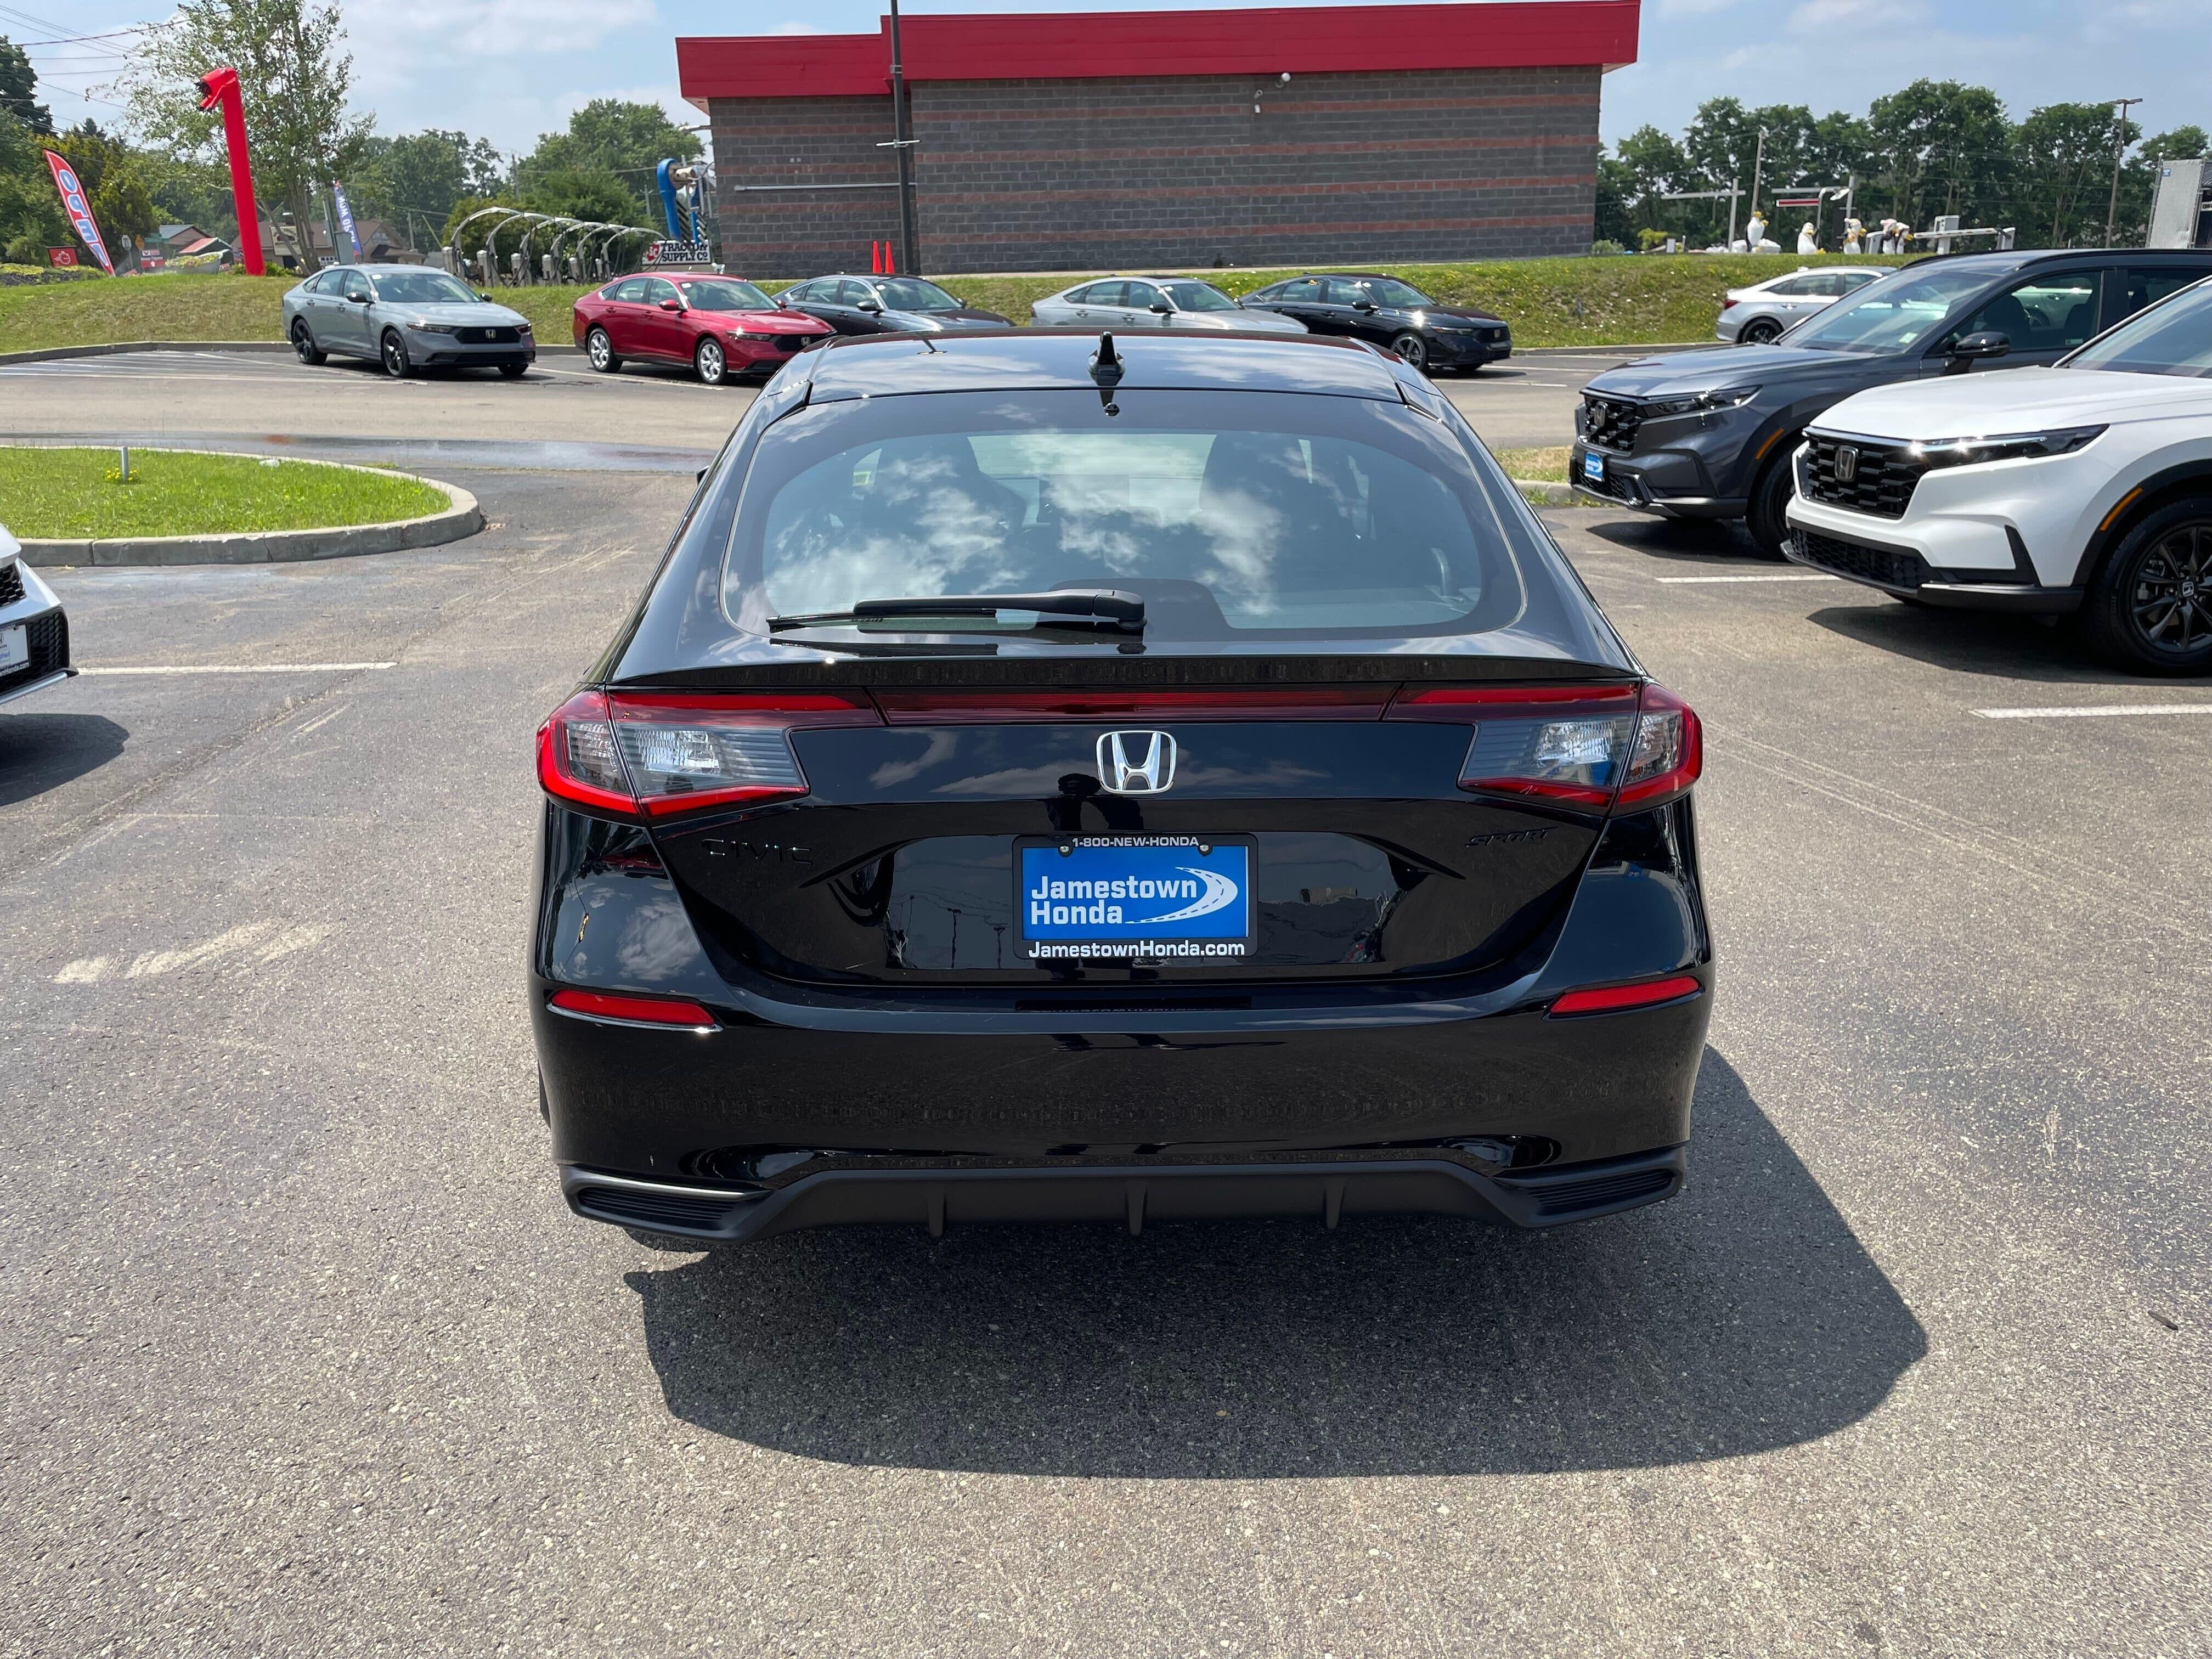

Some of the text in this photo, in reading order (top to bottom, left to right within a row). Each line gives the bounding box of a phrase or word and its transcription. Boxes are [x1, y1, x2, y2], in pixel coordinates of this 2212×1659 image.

[661, 242, 708, 252] TRACOR
[661, 253, 696, 262] SUPPLY
[1071, 837, 1199, 847] 1-800-NEW-HONDA
[701, 838, 814, 865] CIVIC
[1031, 876, 1197, 899] Jamestown
[1031, 899, 1122, 925] Honda
[1028, 940, 1245, 958] JamestownHonda.com
